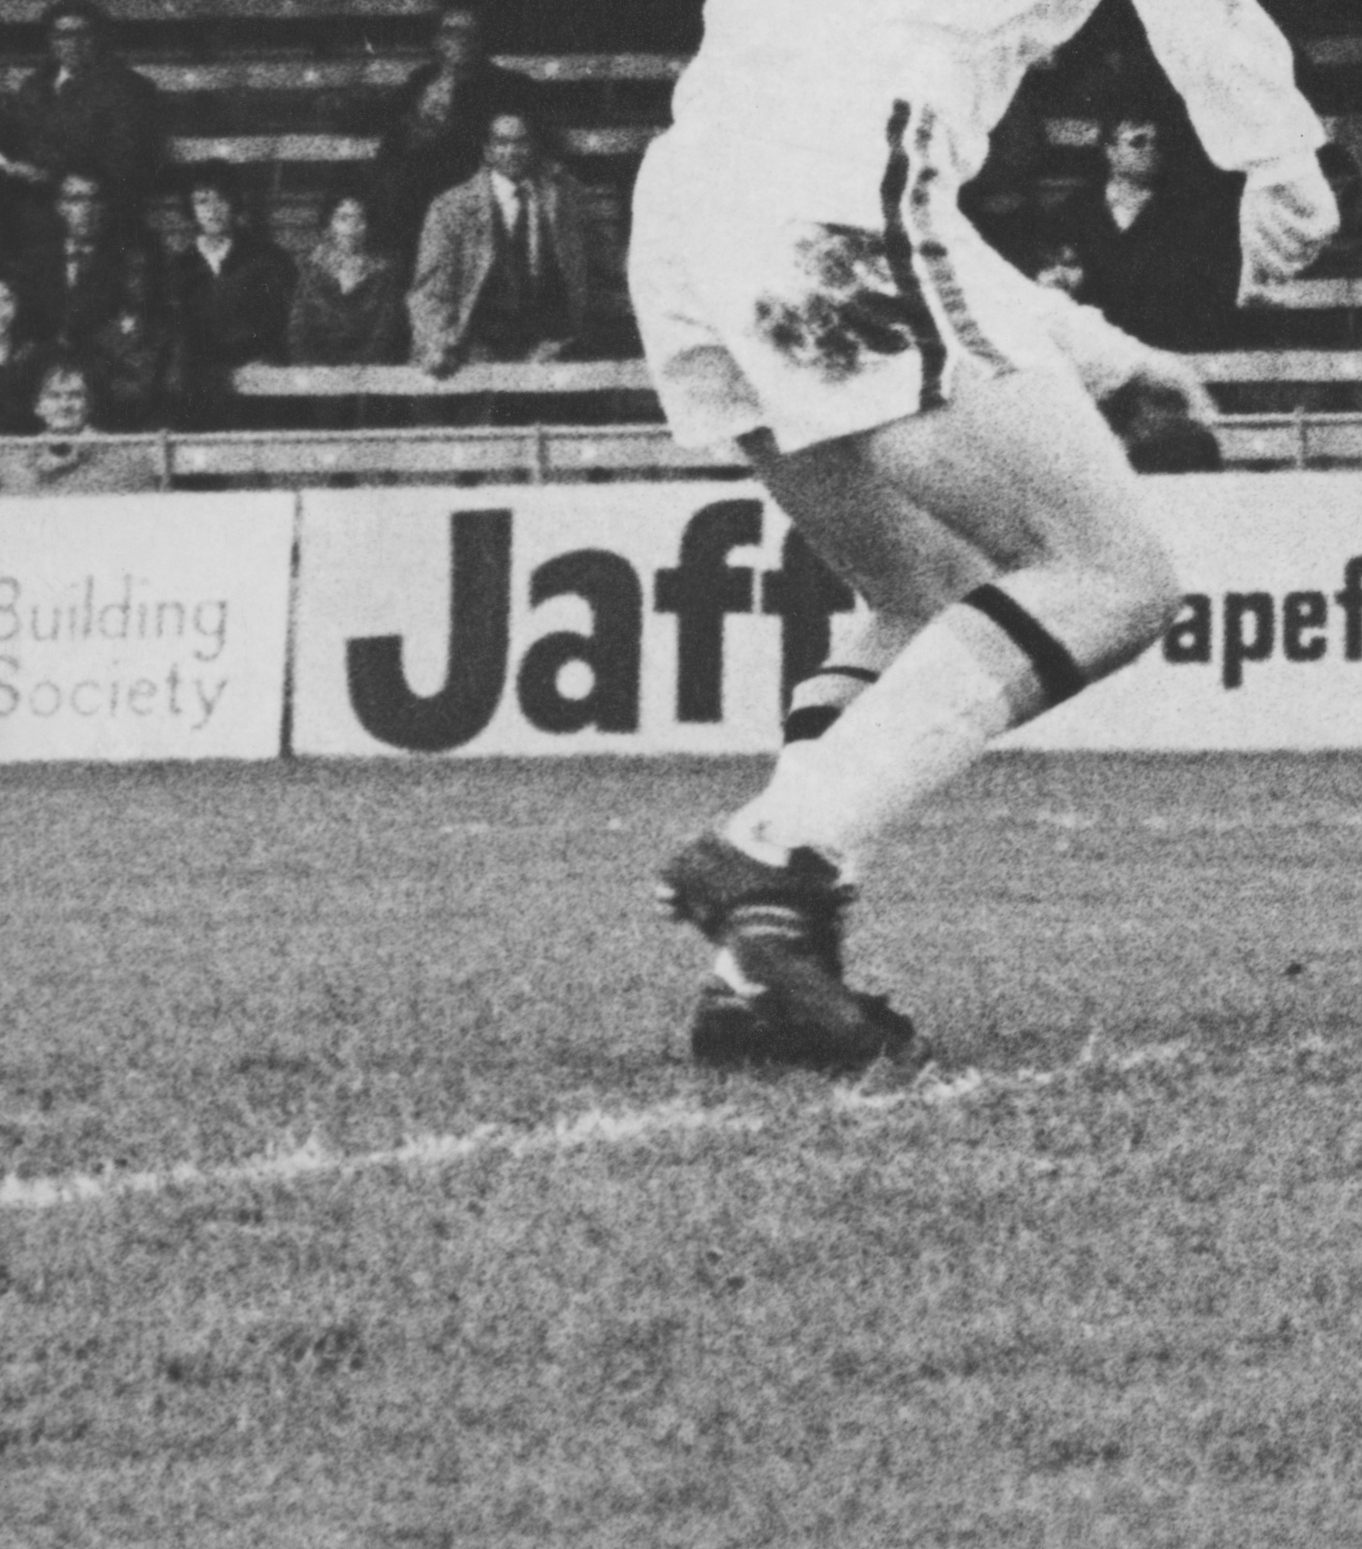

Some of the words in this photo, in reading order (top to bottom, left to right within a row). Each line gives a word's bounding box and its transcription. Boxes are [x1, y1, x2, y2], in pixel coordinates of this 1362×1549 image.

[0, 573, 229, 662] Building
[345, 498, 857, 752] Jaff
[0, 653, 229, 731] Society
